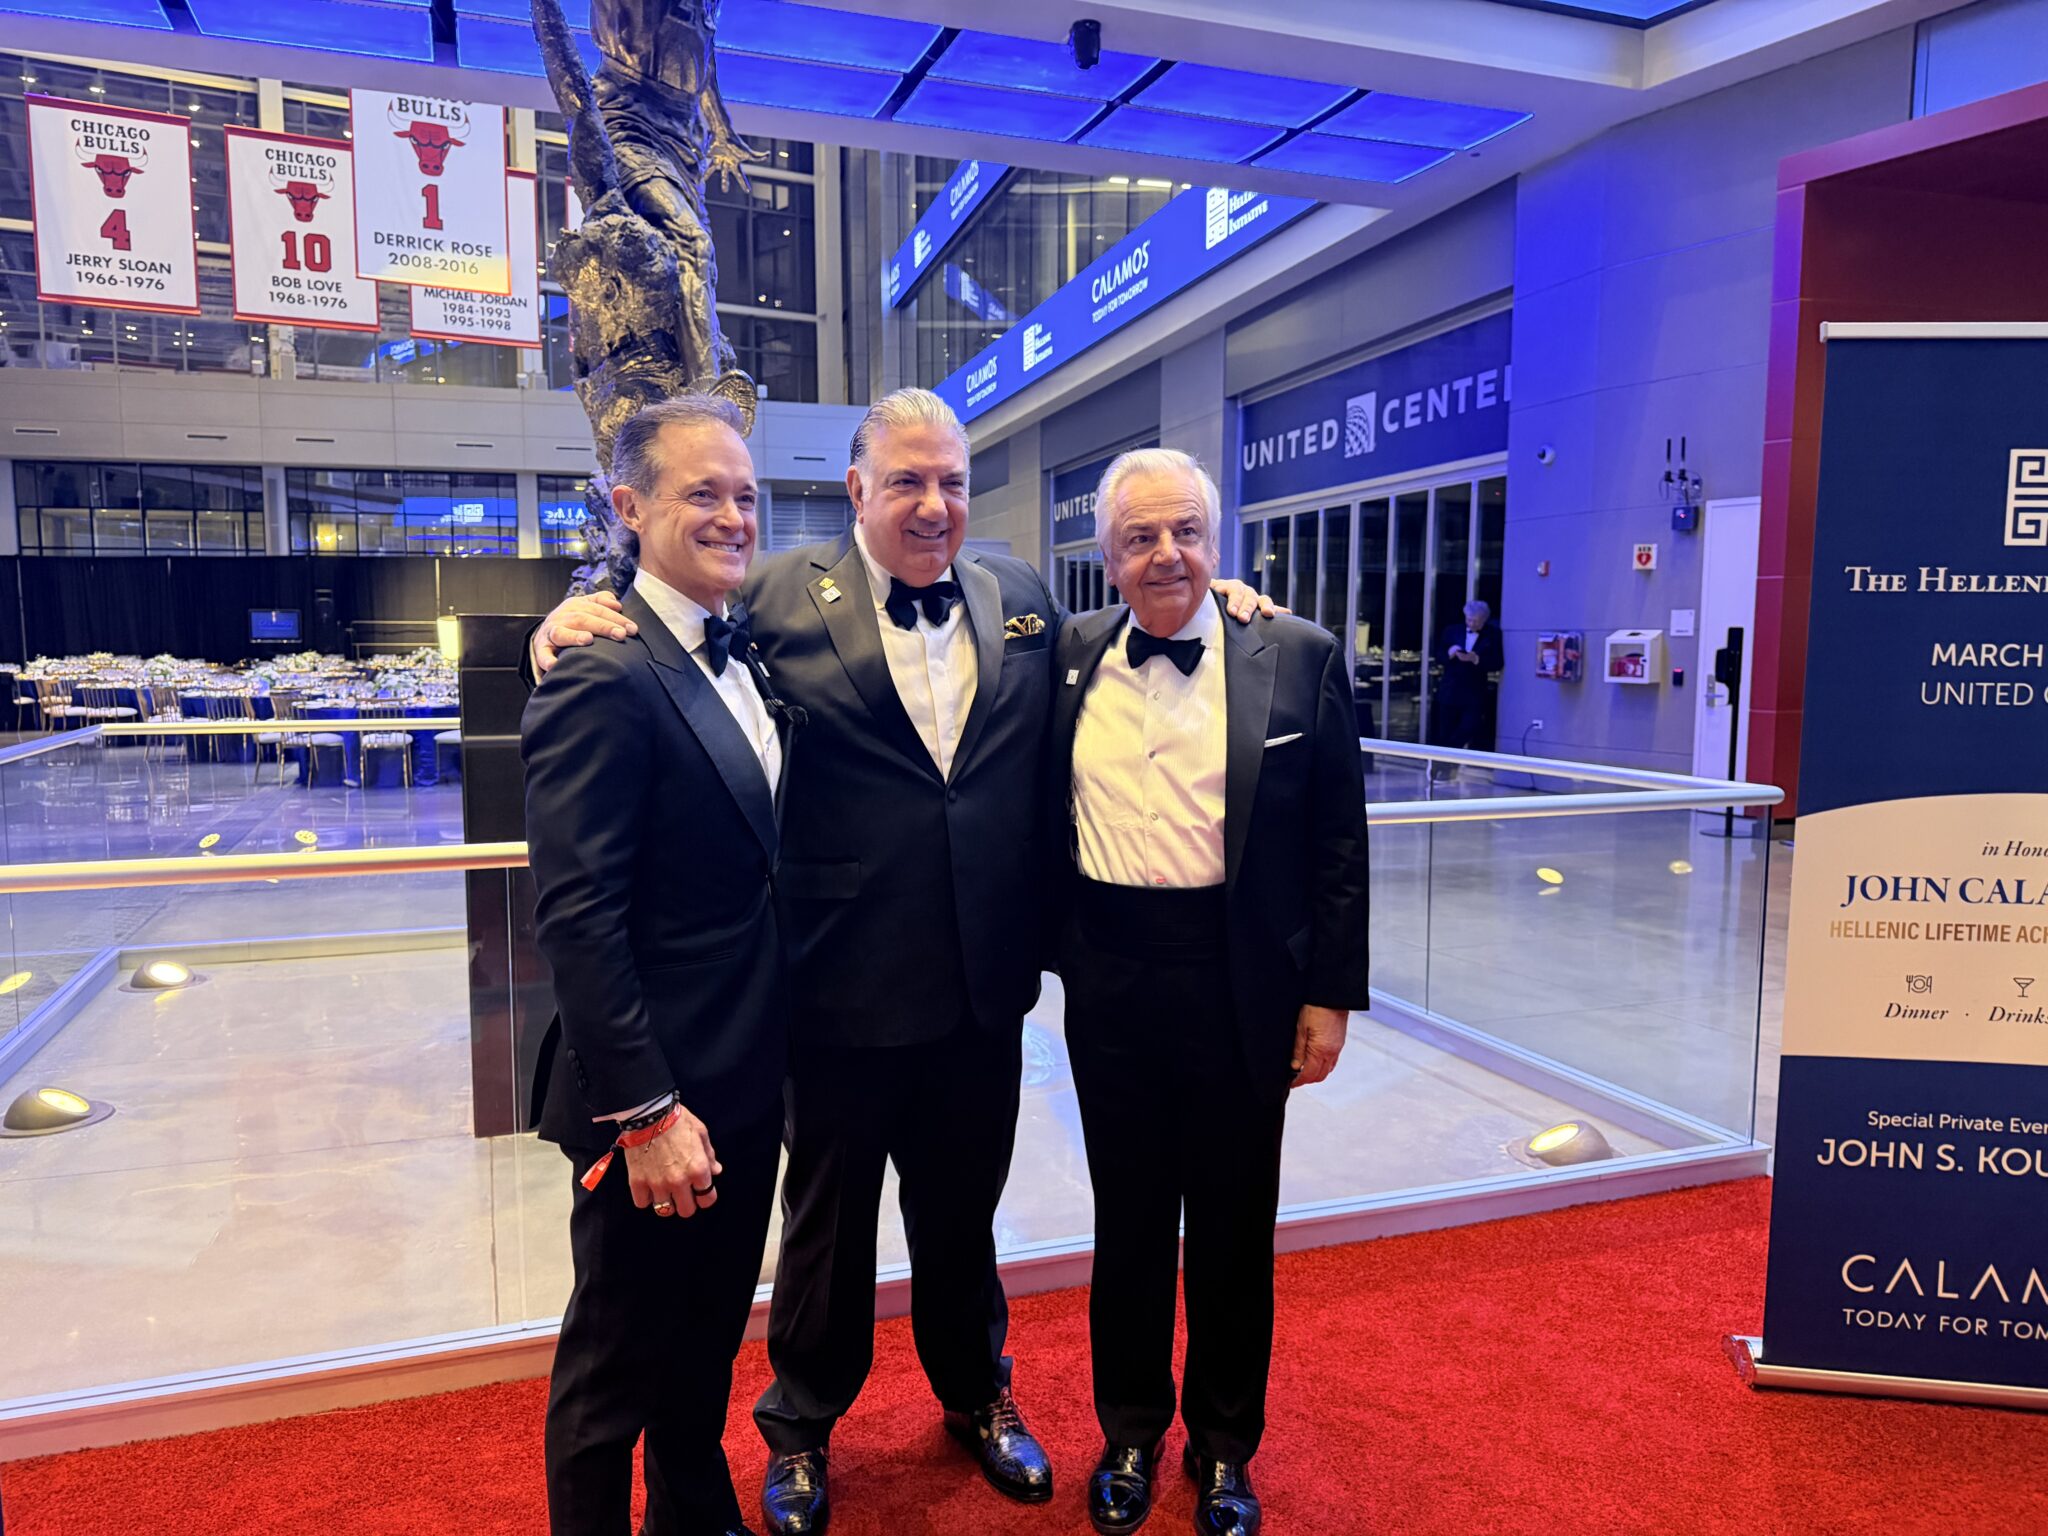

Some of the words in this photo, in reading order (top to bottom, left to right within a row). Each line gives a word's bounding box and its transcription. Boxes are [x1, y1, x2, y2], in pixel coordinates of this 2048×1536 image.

[396, 96, 462, 122] BULLS
[71, 119, 150, 141] CHICAGO
[84, 135, 140, 154] BULLS
[265, 148, 336, 168] CHICAGO
[276, 163, 327, 181] BULLS
[421, 183, 444, 231] 1
[100, 208, 132, 251] 4
[281, 230, 332, 273] 10
[374, 231, 445, 253] DERRICK
[451, 241, 492, 258] ROSE
[66, 253, 112, 269] JERRY
[119, 258, 172, 275] SLOAN
[388, 252, 479, 275] 2008-2016
[76, 271, 165, 290] 1966-1976
[272, 275, 302, 289] BOB
[307, 279, 342, 293] LOVE
[269, 291, 348, 309] 1968-1976
[423, 287, 475, 303] MICHAEL
[479, 294, 527, 308] JORDAN
[443, 302, 511, 319] 1984-1993
[443, 314, 511, 331] 1995-1998
[1243, 418, 1339, 471] UNITED
[1054, 491, 1097, 522] UNITED
[1844, 566, 1907, 592] THE
[1931, 643, 2044, 668] MARCH
[1921, 682, 2034, 706] UNITED
[1981, 841, 1999, 857] in
[1840, 875, 1951, 908] JOHN
[1830, 920, 1920, 940] HELLENIC
[1925, 922, 2011, 943] LIFETIME
[1884, 1002, 1949, 1020] Dinner
[1867, 1110, 1933, 1130] Special
[1939, 1113, 2003, 1132] Private
[1817, 1138, 1924, 1169] JOHN
[1935, 1144, 1964, 1172] S.
[1842, 1308, 1927, 1331] TODAY
[1939, 1315, 1988, 1336] FOR
